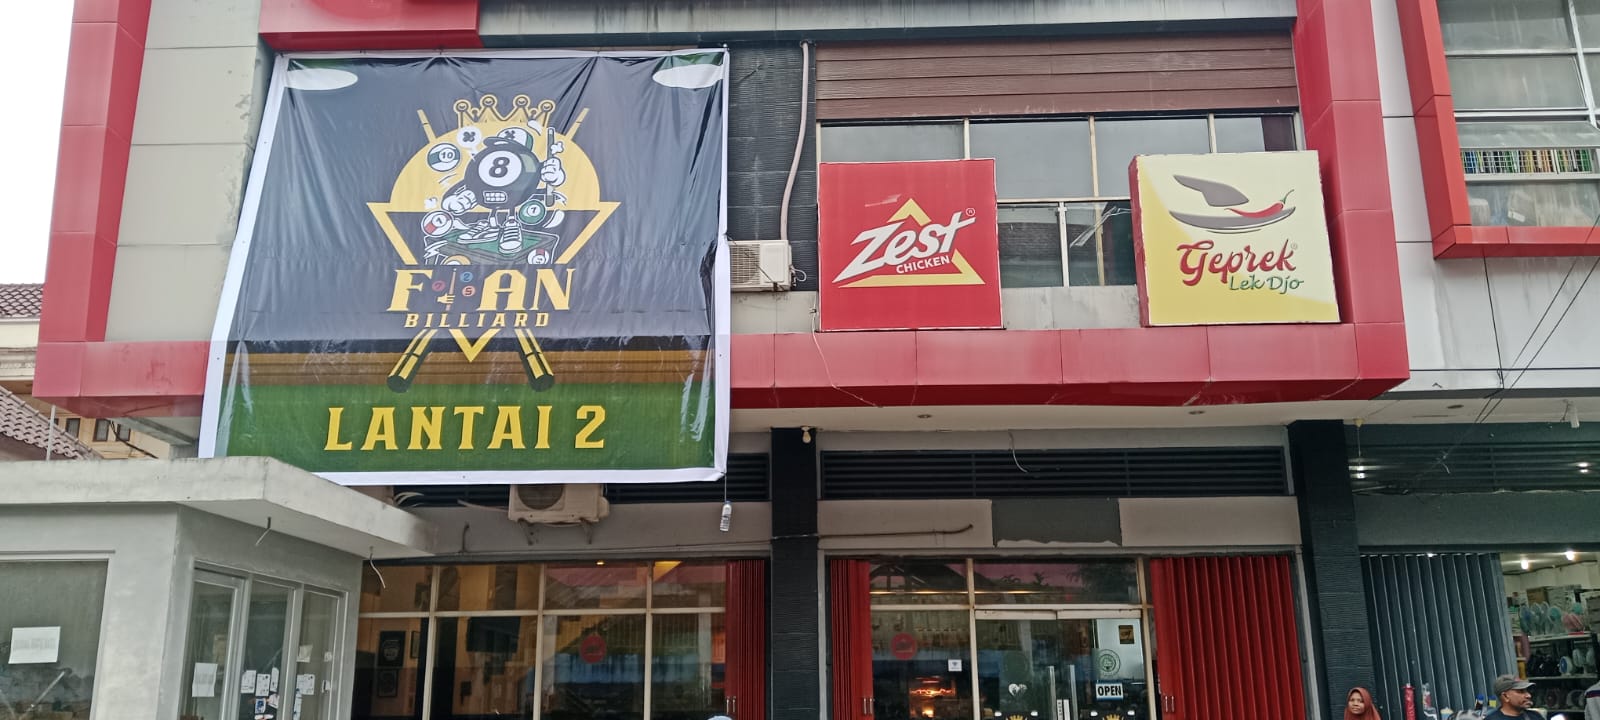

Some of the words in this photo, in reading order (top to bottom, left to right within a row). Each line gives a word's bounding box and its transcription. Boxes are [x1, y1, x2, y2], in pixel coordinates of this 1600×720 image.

[441, 151, 454, 160] 10
[489, 156, 510, 179] 8
[831, 211, 977, 284] Zest
[895, 254, 951, 274] CHICKEN
[1176, 238, 1297, 287] Geprek
[1229, 274, 1265, 291] Lek
[404, 312, 549, 328] BILLIARD
[323, 405, 553, 451] LANTAI
[574, 405, 606, 449] 2
[1097, 685, 1122, 697] OPEN
